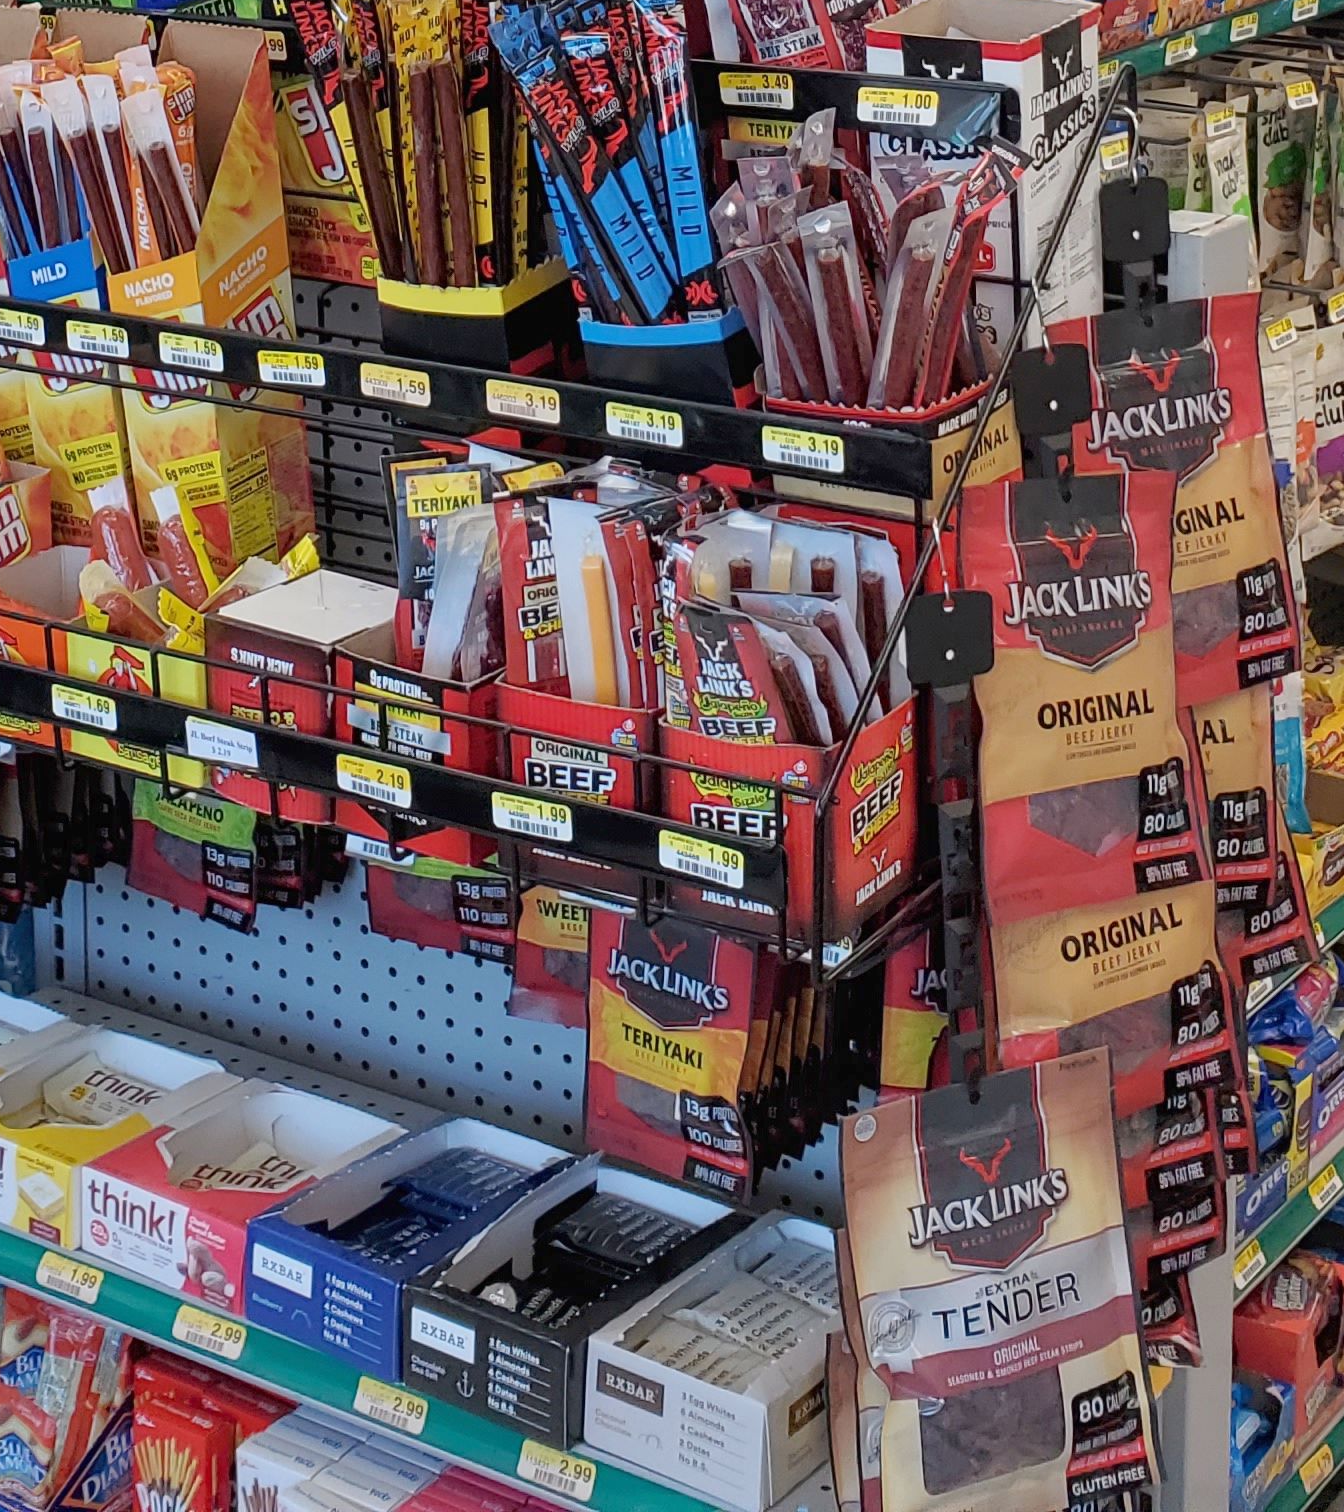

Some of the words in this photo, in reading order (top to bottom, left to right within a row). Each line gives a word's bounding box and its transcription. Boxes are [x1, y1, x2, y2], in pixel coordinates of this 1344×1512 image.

[785, 32, 823, 55] STEAK
[761, 73, 790, 90] 3.49
[902, 92, 933, 110] 1.00
[1031, 94, 1096, 171] CLASSICS
[472, 150, 488, 209] HOT
[670, 166, 703, 238] MILD
[31, 262, 67, 286] MILD
[217, 245, 269, 295] NACHO
[123, 273, 175, 298] NACHO
[16, 313, 40, 331] 1.59
[101, 326, 125, 345] 1.59
[192, 337, 217, 357] 1.59
[396, 378, 426, 395] 1.59
[525, 393, 557, 411] 3.19
[646, 412, 676, 430] 3.19
[63, 447, 77, 463] 6g
[77, 441, 115, 460] PROTEIN
[808, 436, 839, 456] 3.19
[411, 494, 477, 516] TERIYAKI
[1003, 576, 1077, 626] JACK
[1074, 571, 1152, 612] LINK'S
[701, 658, 743, 680] JACK
[382, 676, 422, 700] PROTEIN
[696, 676, 755, 698] LINK'S
[85, 696, 111, 715] 1.69
[1037, 688, 1155, 730] ORIGINAL
[699, 718, 775, 736] BEEF
[1065, 730, 1095, 746] BEEF
[1100, 723, 1135, 742] JERKY
[201, 732, 215, 742] Beef
[217, 737, 235, 747] Steak
[376, 771, 405, 791] 2.19
[526, 757, 615, 793] BEEF
[1146, 773, 1167, 796] 11g
[734, 793, 765, 808] Sizzle
[536, 802, 568, 823] 1.99
[1143, 813, 1165, 835] 80
[206, 847, 225, 867] 13g
[707, 847, 739, 870] 1.99
[1216, 838, 1239, 858] 80
[206, 871, 224, 887] 110
[536, 897, 589, 923] SWEET
[1060, 902, 1183, 962] ORIGINAL
[622, 1024, 704, 1072] TERIYAKI
[685, 1098, 709, 1122] 13g
[1244, 1160, 1290, 1219] OREO
[88, 1179, 177, 1245] think!
[908, 1187, 997, 1247] JACK
[990, 1168, 1069, 1226] LINK'S
[69, 1267, 98, 1290] 1.99
[261, 1257, 303, 1284] RXBAR
[985, 1271, 1030, 1298] EXTRA
[932, 1271, 1081, 1339] TENDER
[212, 1322, 243, 1344] 2.99
[420, 1322, 465, 1349] RXBAR
[605, 1372, 656, 1403] RXBAR
[393, 1394, 424, 1420] 2.99
[1079, 1397, 1104, 1423] 80
[559, 1458, 592, 1484] 2.99
[1071, 1473, 1118, 1497] GLUTEN
[1119, 1466, 1146, 1486] FREE
